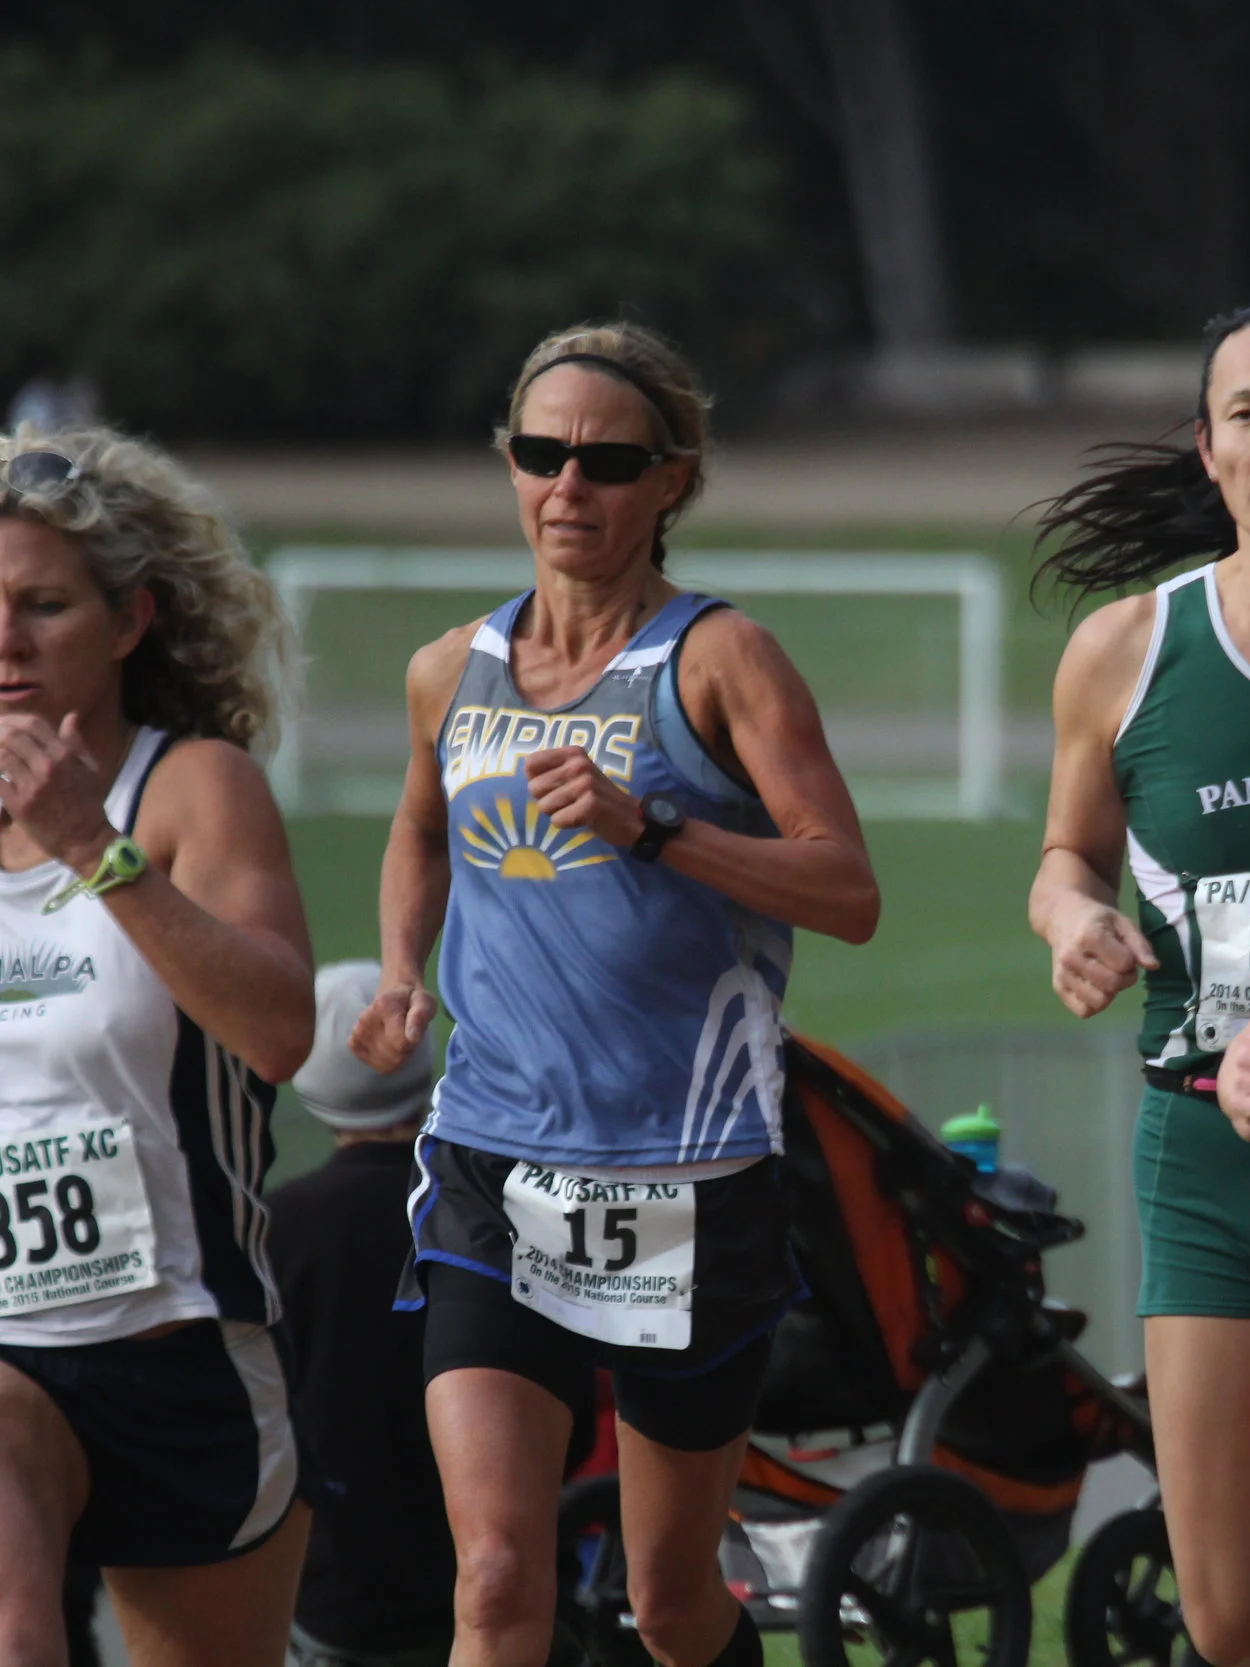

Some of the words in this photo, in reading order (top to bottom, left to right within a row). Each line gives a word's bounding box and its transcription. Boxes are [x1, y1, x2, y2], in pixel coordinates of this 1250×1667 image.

[0, 955, 97, 981] ALPA
[1209, 983, 1240, 1000] 2014
[0, 1136, 70, 1177] SATF
[79, 1128, 118, 1163] XC
[563, 1208, 638, 1272] 15
[4, 1250, 143, 1294] CHAMPIONSHIPS
[42, 1283, 91, 1301] National
[94, 1274, 136, 1291] Course
[529, 1264, 542, 1277] On
[544, 1267, 559, 1285] the
[583, 1288, 627, 1303] National
[629, 1292, 667, 1304] Course
[559, 1264, 678, 1292] CHAMPIONSHIPS
